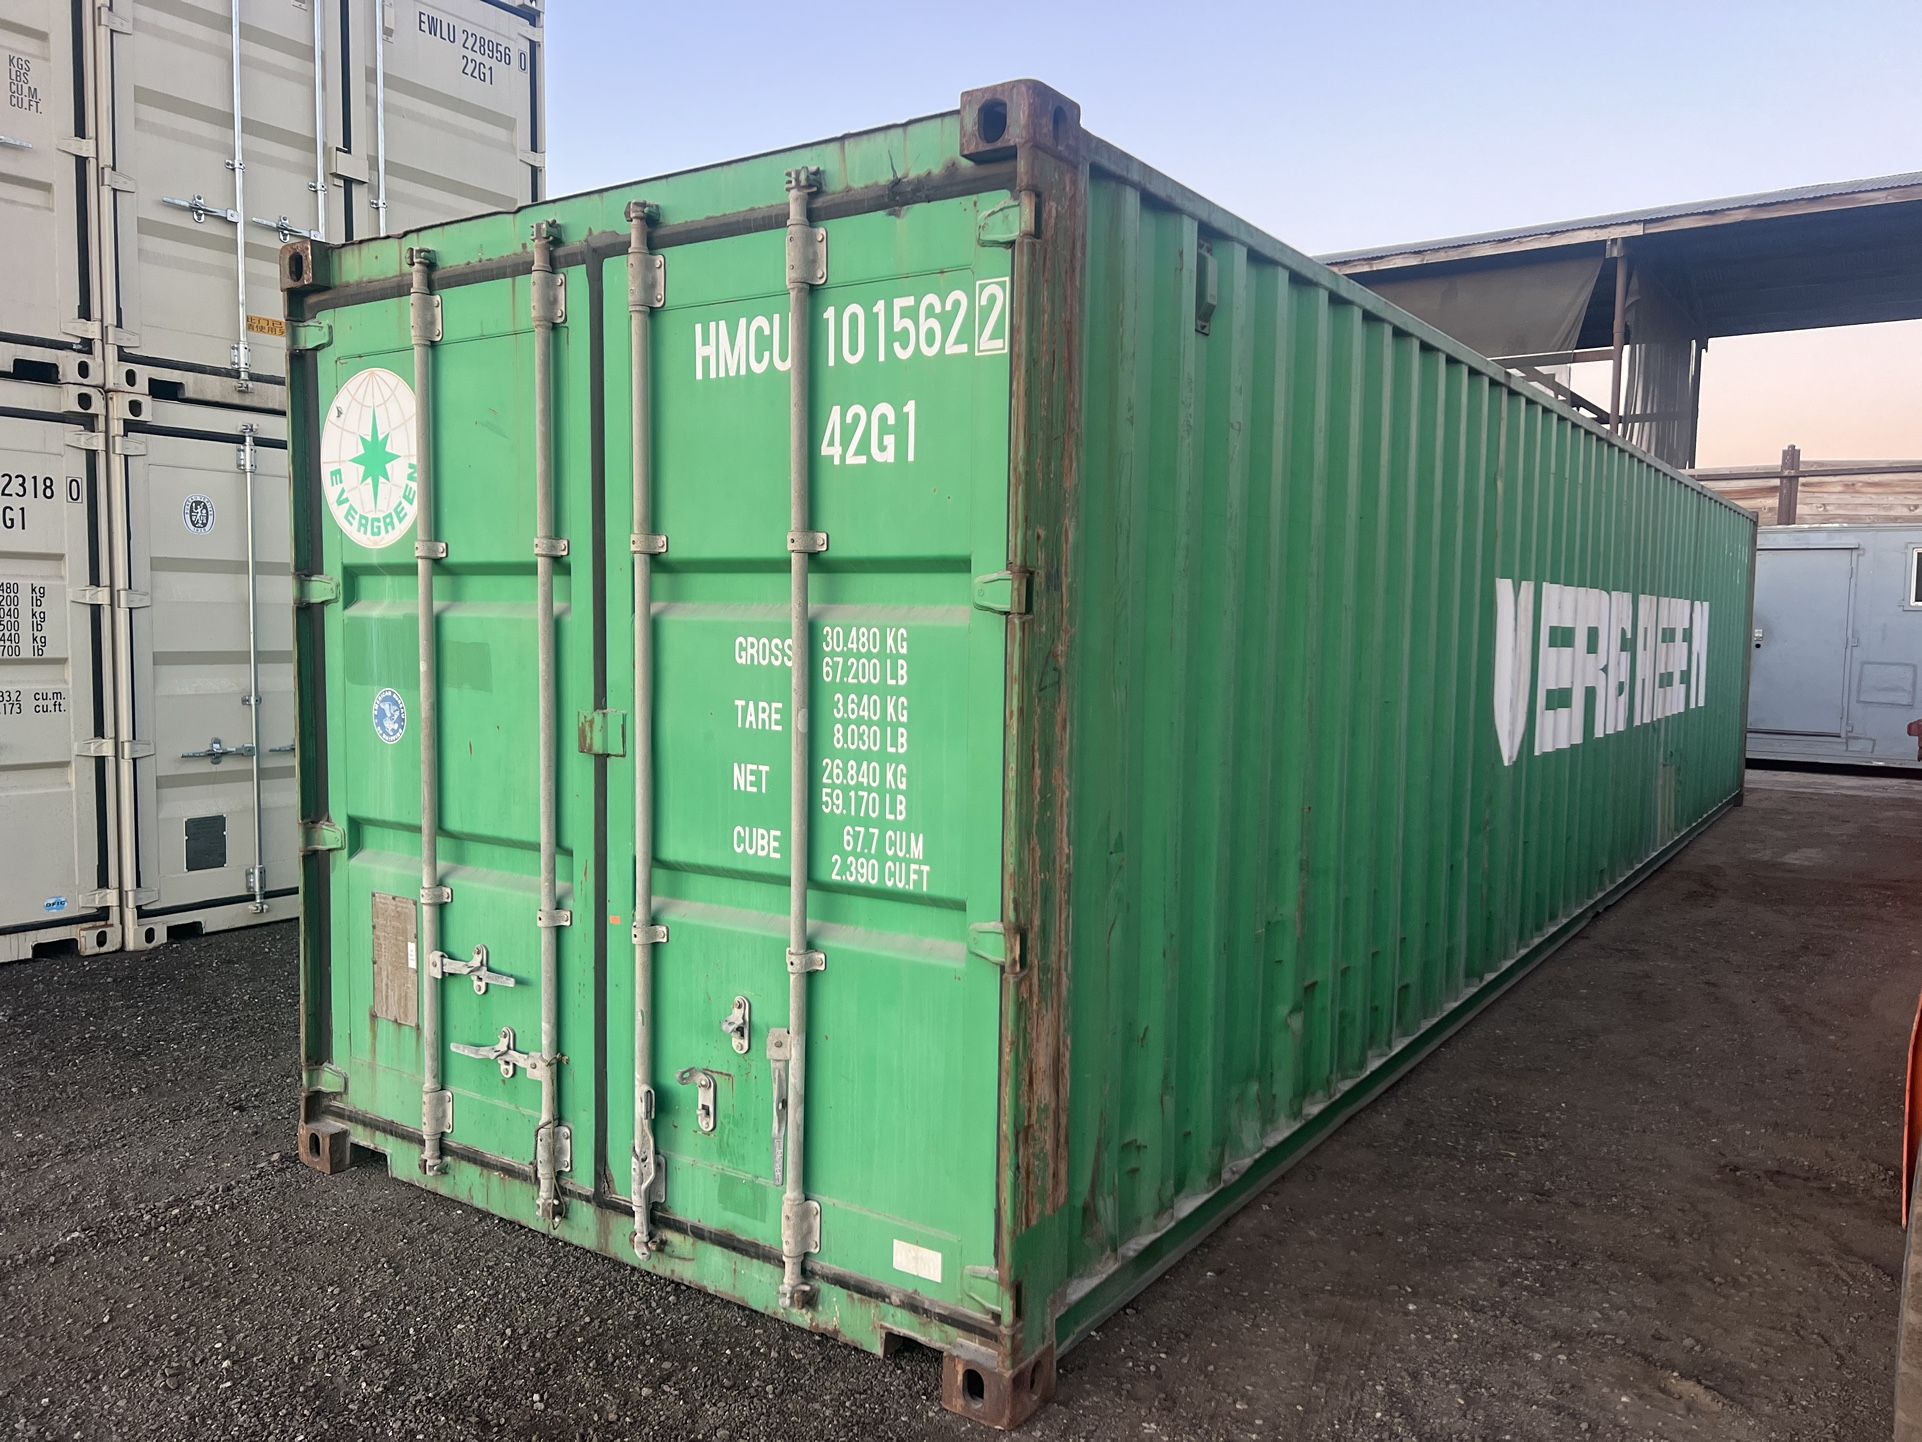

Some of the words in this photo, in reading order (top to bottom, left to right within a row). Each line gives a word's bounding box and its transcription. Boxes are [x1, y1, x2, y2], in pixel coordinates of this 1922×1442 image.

[418, 11, 456, 44] EWLU
[462, 29, 511, 66] 228956
[519, 52, 527, 71] 0
[9, 54, 31, 72] KGS
[9, 68, 29, 85] LBS
[462, 55, 493, 86] 22G1
[9, 81, 41, 102] CU.M.
[9, 94, 43, 115] CU.FT.
[695, 312, 792, 380] HMCU
[821, 400, 915, 465] 42G1
[0, 473, 55, 500] 2318
[68, 478, 81, 502] 0
[330, 463, 417, 537] EVERGREEN
[2, 505, 26, 530] G1
[30, 583, 46, 598] kg
[31, 595, 43, 607] lb
[31, 608, 46, 623] kg
[31, 620, 43, 632] lb
[0, 632, 20, 645] 440
[32, 633, 47, 648] kg
[0, 644, 21, 657] 700
[32, 645, 44, 657] lb
[735, 636, 793, 667] GROSS
[822, 626, 880, 653] 30.480
[886, 627, 908, 654] KG
[822, 656, 880, 684] 67.200
[886, 658, 908, 686] LB
[33, 691, 66, 701] cu.m.
[34, 701, 67, 714] cu.ft.
[734, 699, 783, 731] TARE
[833, 693, 881, 721] 3.640
[886, 695, 908, 723] KG
[833, 723, 881, 751] 8.030
[886, 726, 908, 754] LB
[733, 762, 770, 793] NET
[822, 758, 880, 787] 26.840
[886, 762, 907, 790] KG
[821, 788, 879, 818] 59.170
[885, 793, 907, 821] LB
[733, 825, 781, 859] CUBE
[843, 825, 879, 854] 67.7
[885, 830, 924, 860] CU.M
[831, 854, 878, 885] 2.390
[884, 860, 930, 892] CU.FT
